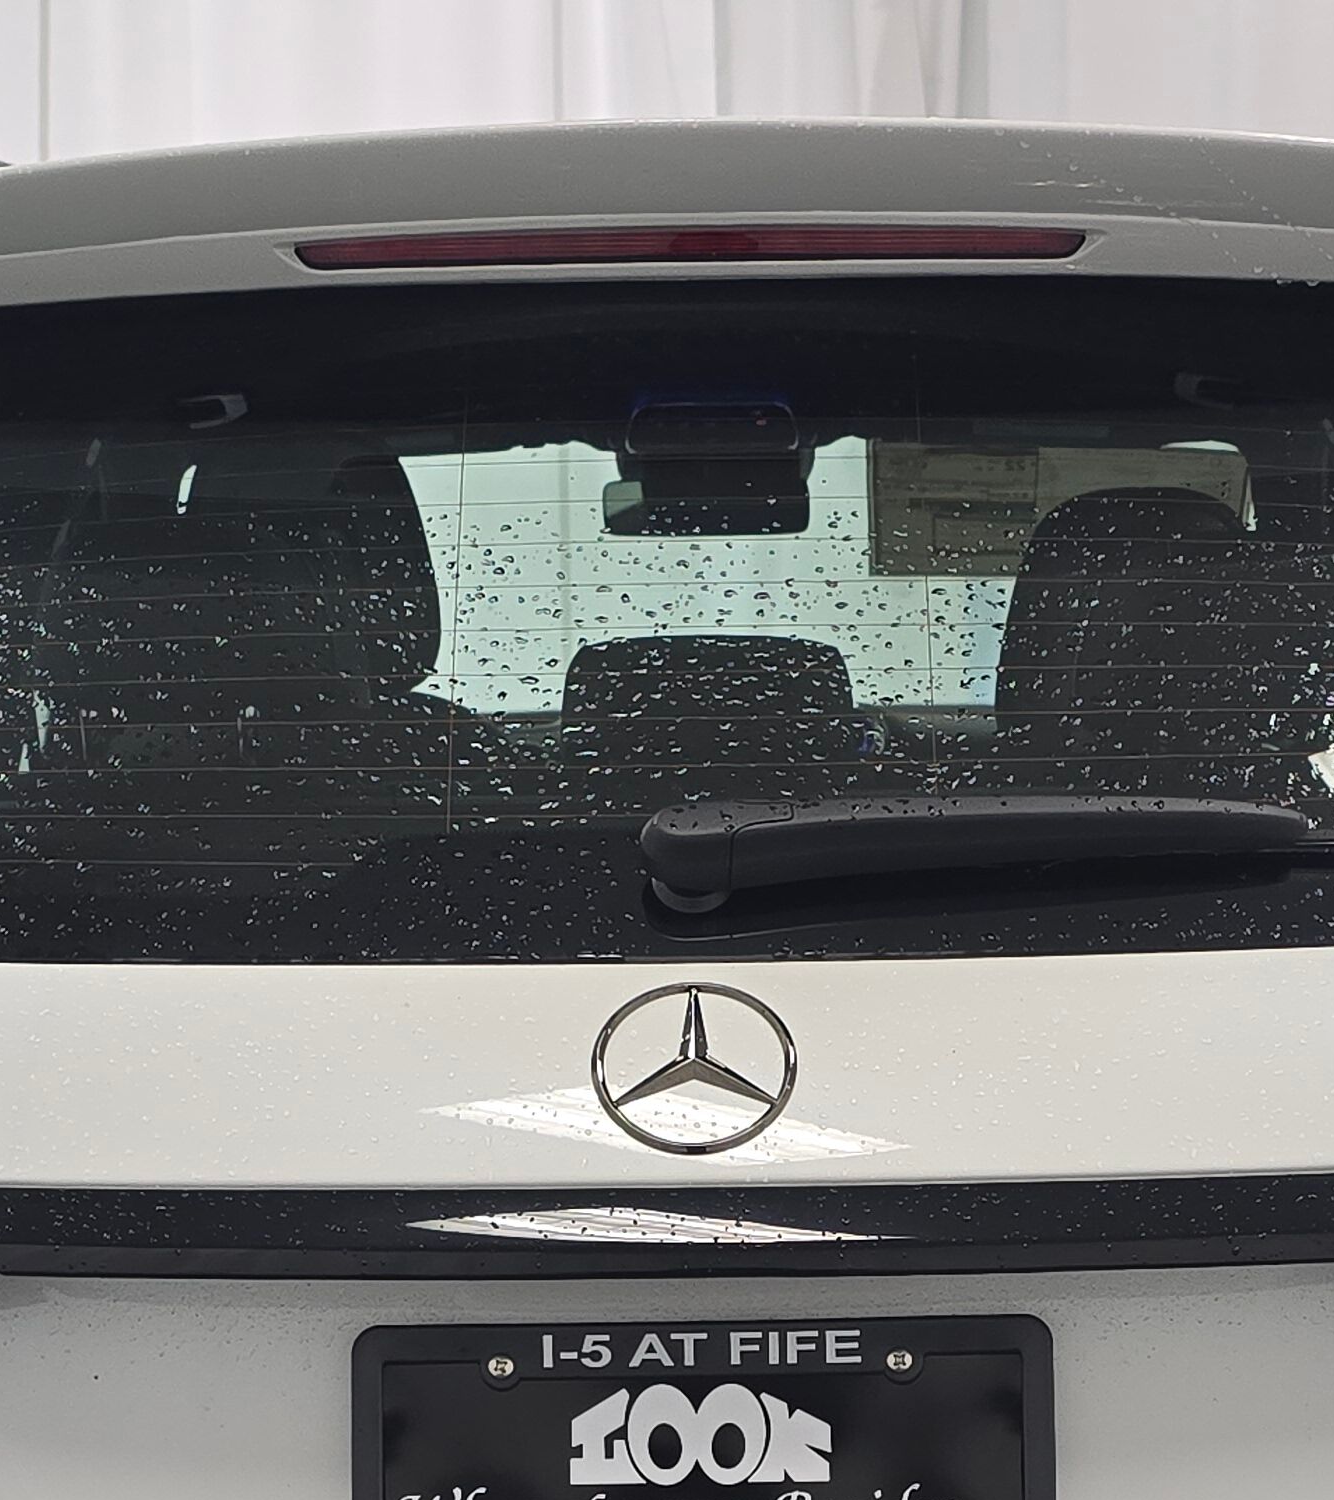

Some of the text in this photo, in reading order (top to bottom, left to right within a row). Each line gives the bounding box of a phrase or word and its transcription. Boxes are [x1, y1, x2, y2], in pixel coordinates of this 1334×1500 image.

[542, 1329, 862, 1368] I-5 AT FIFE
